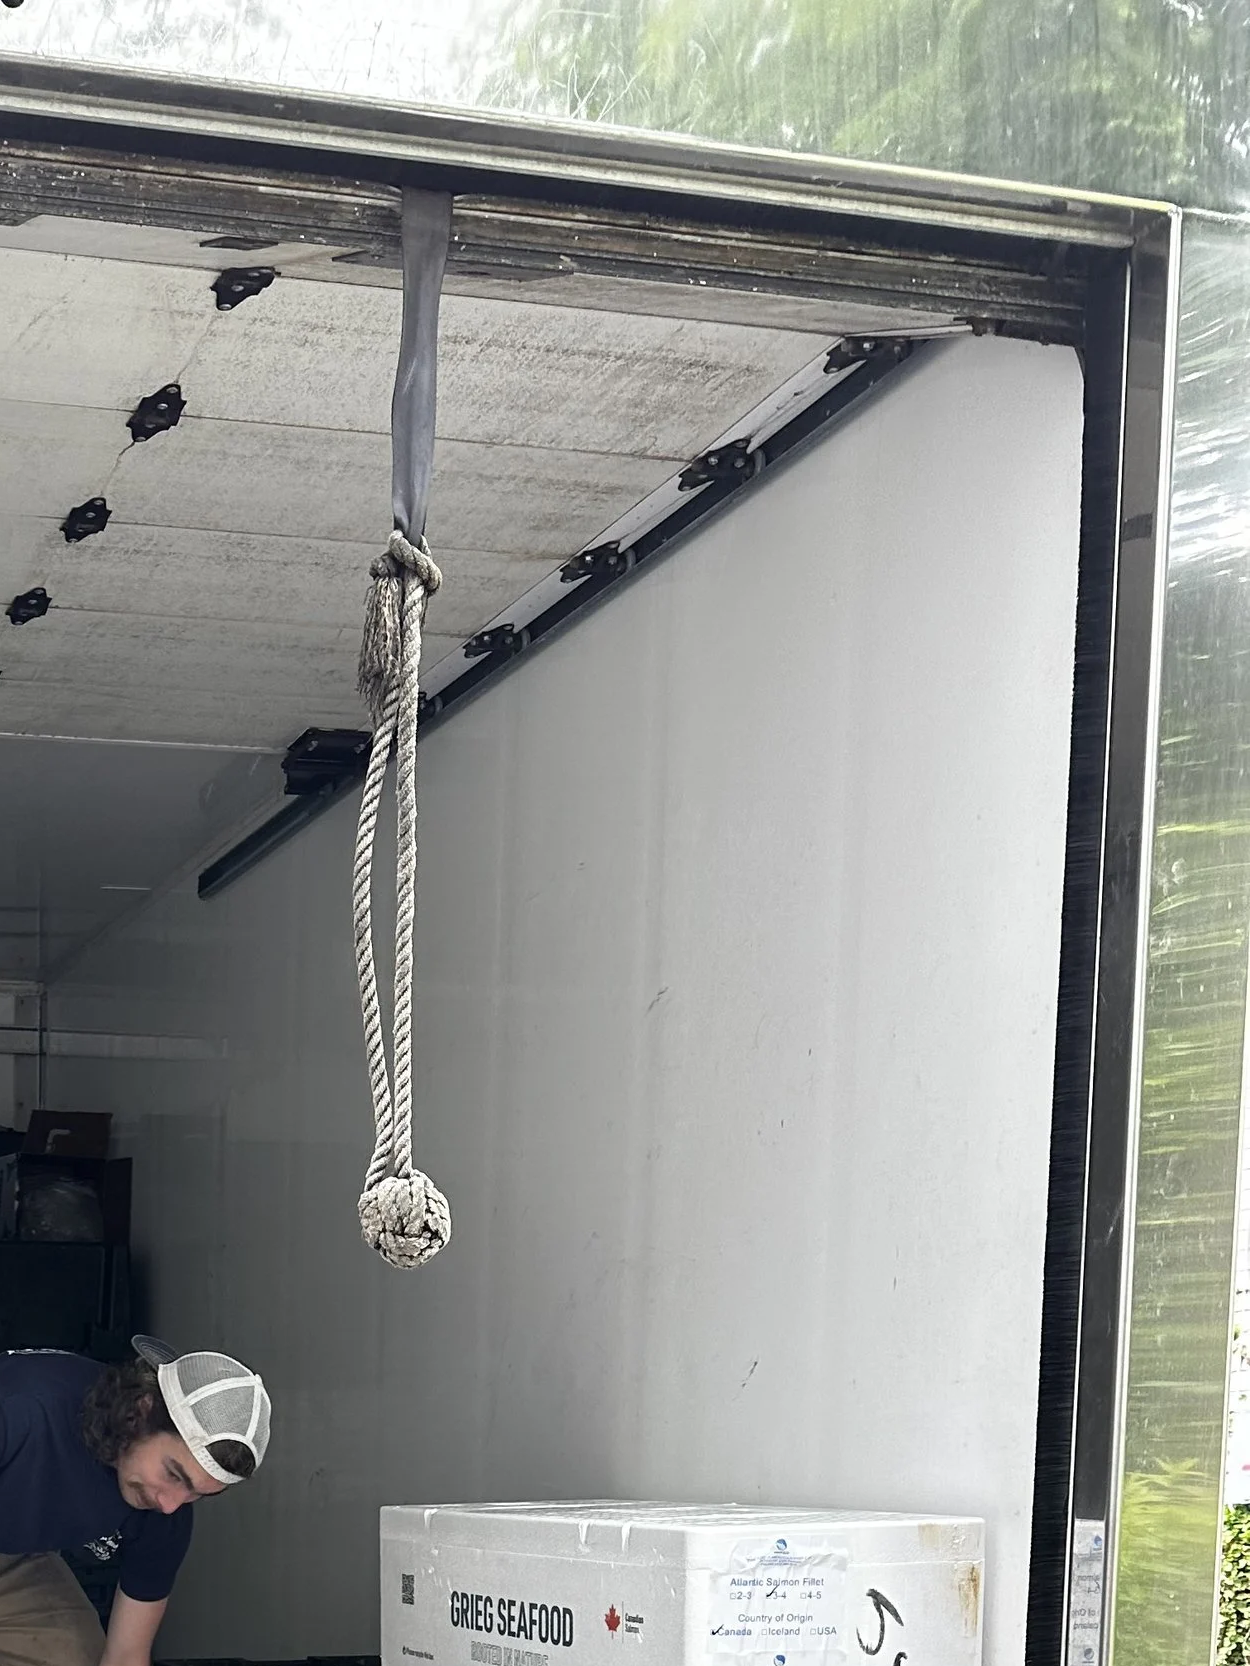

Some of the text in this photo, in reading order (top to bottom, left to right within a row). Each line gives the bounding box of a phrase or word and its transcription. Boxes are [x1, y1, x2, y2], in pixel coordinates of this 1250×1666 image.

[730, 1577, 824, 1587] Atlantic Salmon Fillet
[451, 1590, 573, 1647] GRIEG SEAFOOD
[738, 1613, 813, 1624] Country of Origin
[717, 1626, 837, 1636] Canada Iceland USA
[471, 1641, 502, 1666] ROOTED
